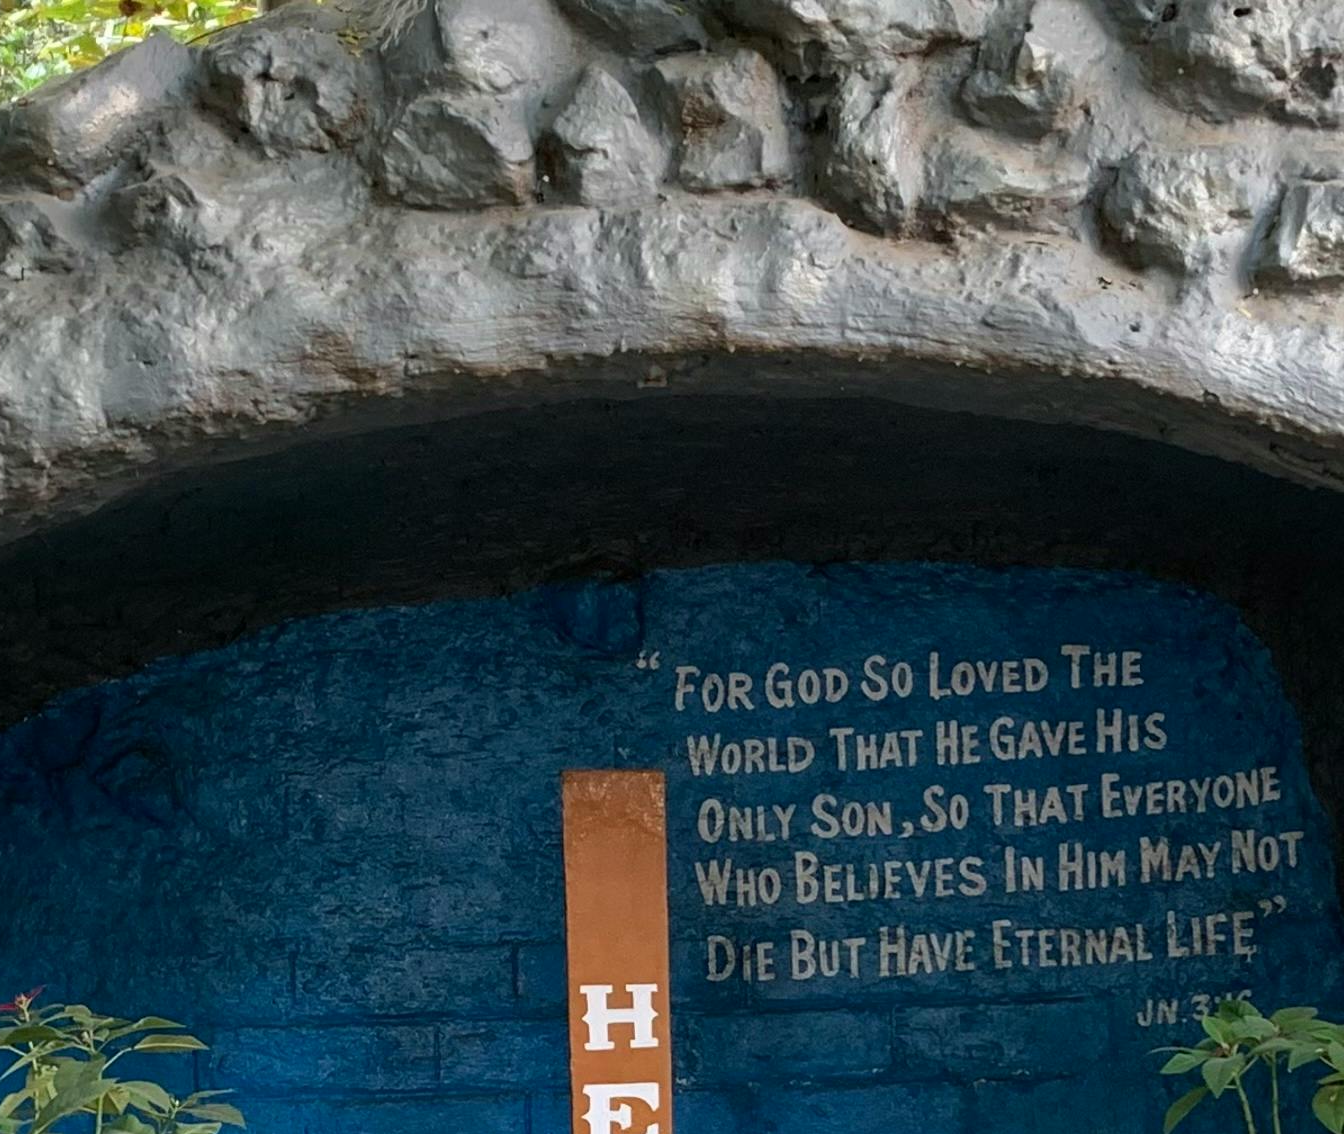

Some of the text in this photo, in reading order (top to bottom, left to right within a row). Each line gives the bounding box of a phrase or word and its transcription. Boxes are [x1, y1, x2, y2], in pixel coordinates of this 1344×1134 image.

[765, 662, 849, 709] GOD
[860, 655, 913, 701] SO
[929, 651, 1049, 701] LOVED
[1061, 644, 1144, 689] THE
[687, 708, 1168, 776] WORLD THAT HE GAVE HIS
[697, 766, 1281, 843] ONLY SON, SO THAT EVERYONE
[694, 829, 1305, 907] WHO BELIEVES IN HIM MAY NOT
[706, 935, 776, 984] DIE
[789, 928, 867, 981] BUT
[878, 924, 975, 977] HAVE
[992, 919, 1154, 969] ETERNAL
